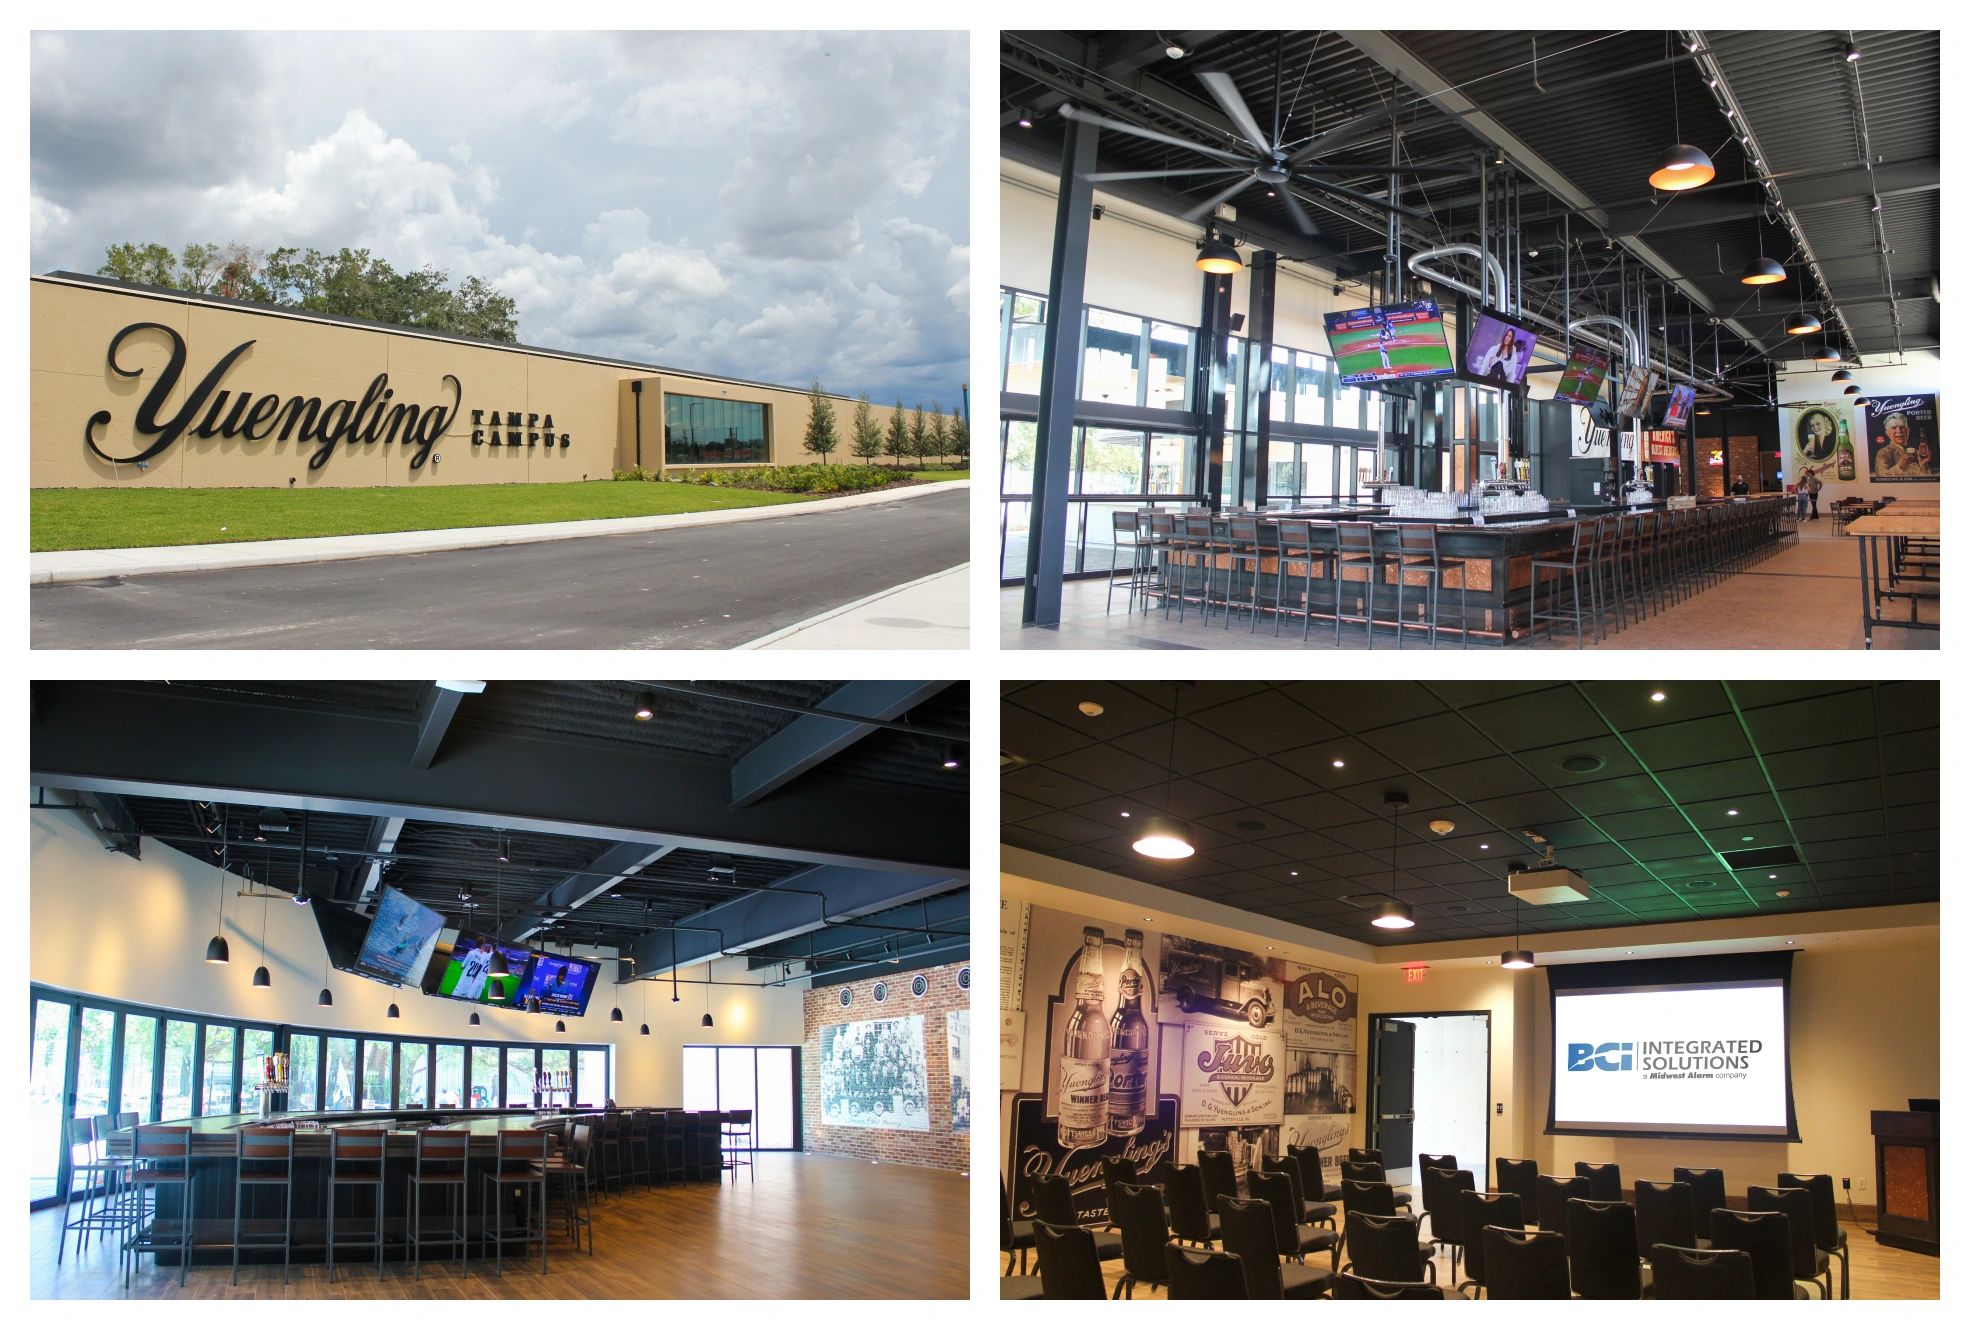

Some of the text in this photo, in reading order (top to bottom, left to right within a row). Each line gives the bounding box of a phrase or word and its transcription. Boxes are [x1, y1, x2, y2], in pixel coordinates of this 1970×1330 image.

[86, 322, 462, 469] Yuengling
[1871, 396, 1924, 418] Yuengling
[471, 409, 554, 428] TAMPA
[471, 430, 571, 448] CAMPUS
[1408, 969, 1424, 982] EXIT
[1298, 978, 1347, 1009] ALO
[1204, 1029, 1229, 1037] SERVE
[1643, 1040, 1763, 1055] INTEGRATED
[1197, 1044, 1275, 1074] Juvo
[1643, 1056, 1749, 1071] SOLUTIONS
[1650, 1072, 1685, 1080] Midwest
[1715, 1072, 1747, 1080] company
[1070, 1094, 1098, 1104] WINNER
[1213, 1104, 1248, 1115] YUENGLING
[1077, 1207, 1109, 1219] TASTE
